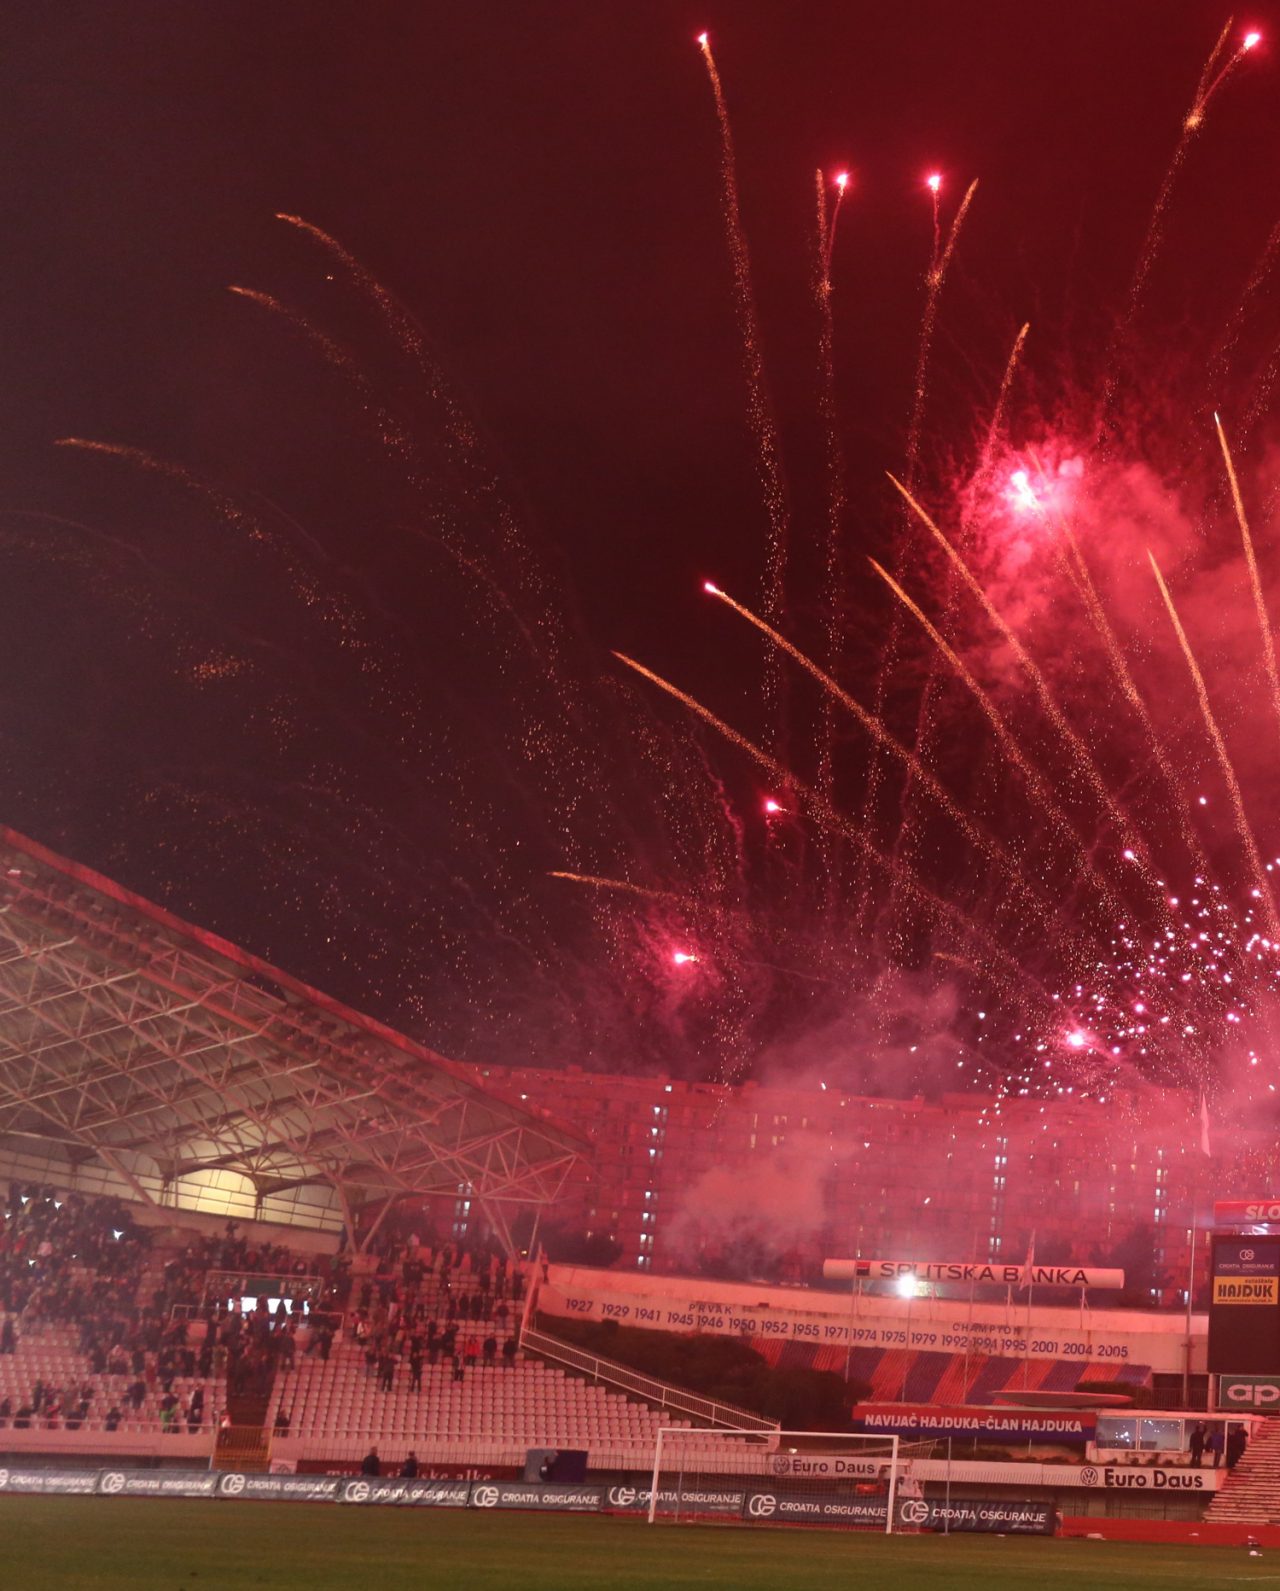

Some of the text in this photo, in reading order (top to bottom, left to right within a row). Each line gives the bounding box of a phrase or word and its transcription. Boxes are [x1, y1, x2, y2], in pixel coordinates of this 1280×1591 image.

[880, 1262, 995, 1281] SPLITSKA
[1217, 1284, 1274, 1298] HAJDUK
[688, 1302, 732, 1315] PRVAK
[565, 1298, 593, 1313] 1927
[602, 1303, 630, 1317] 1929
[634, 1307, 662, 1321] 1941
[667, 1311, 694, 1326] 1945
[697, 1315, 724, 1329] 1946
[729, 1317, 756, 1332] 1950
[761, 1320, 788, 1334] 1952
[793, 1323, 820, 1337] 1955
[825, 1325, 849, 1339] 1971
[852, 1328, 877, 1341] 1974
[881, 1330, 906, 1343] 1975
[911, 1332, 937, 1345] 1979
[941, 1334, 968, 1348] 1992
[1002, 1339, 1027, 1351] 1995
[1031, 1340, 1058, 1353] 2001
[1063, 1342, 1093, 1356] 2004
[1097, 1344, 1129, 1358] 2005
[865, 1412, 917, 1427] NAVIJAČ
[1022, 1419, 1083, 1433] HAJDUKA
[792, 1459, 829, 1473] Euro
[835, 1460, 875, 1474] Daus
[1104, 1468, 1147, 1487] Euro
[1153, 1469, 1204, 1488] Daus
[502, 1493, 600, 1505] CROATIA OSIGURANJE
[638, 1491, 741, 1504] CRATIA OSIGURANJE
[779, 1502, 888, 1517] CROATIA OSIGURANJE
[932, 1508, 1047, 1523] CROATIA OSIGURANJE
